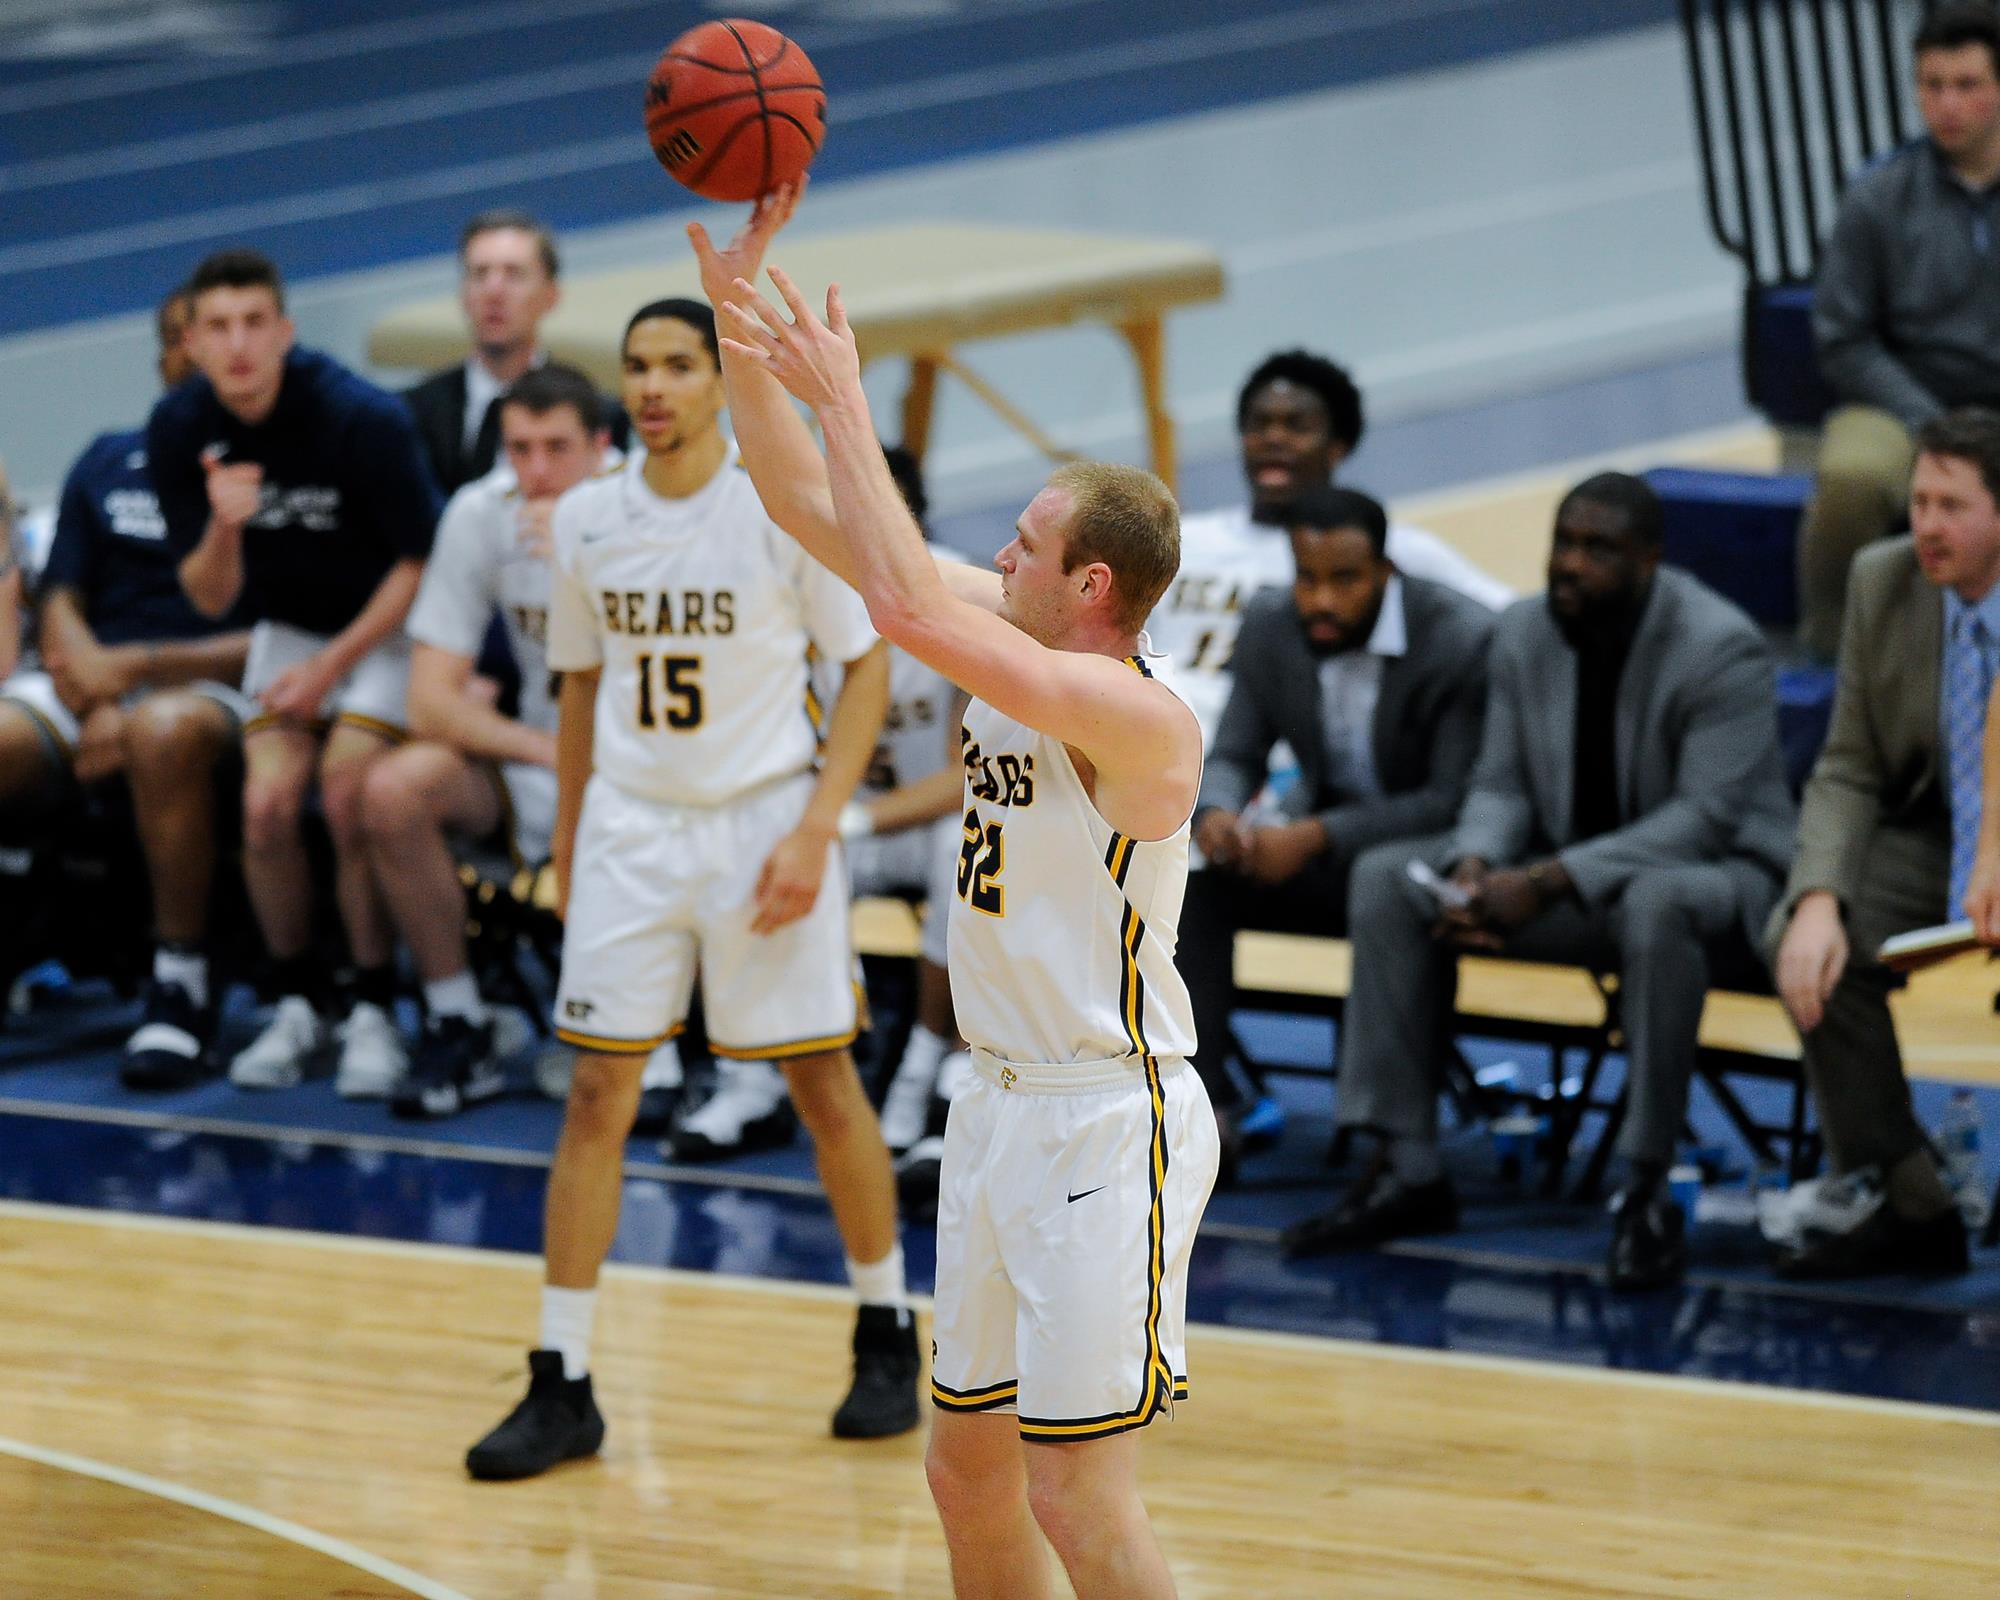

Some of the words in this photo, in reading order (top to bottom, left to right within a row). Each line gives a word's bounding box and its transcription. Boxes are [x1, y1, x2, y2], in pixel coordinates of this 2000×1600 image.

[602, 590, 735, 636] BEARS
[636, 654, 704, 731] 15
[957, 804, 1006, 918] 32
